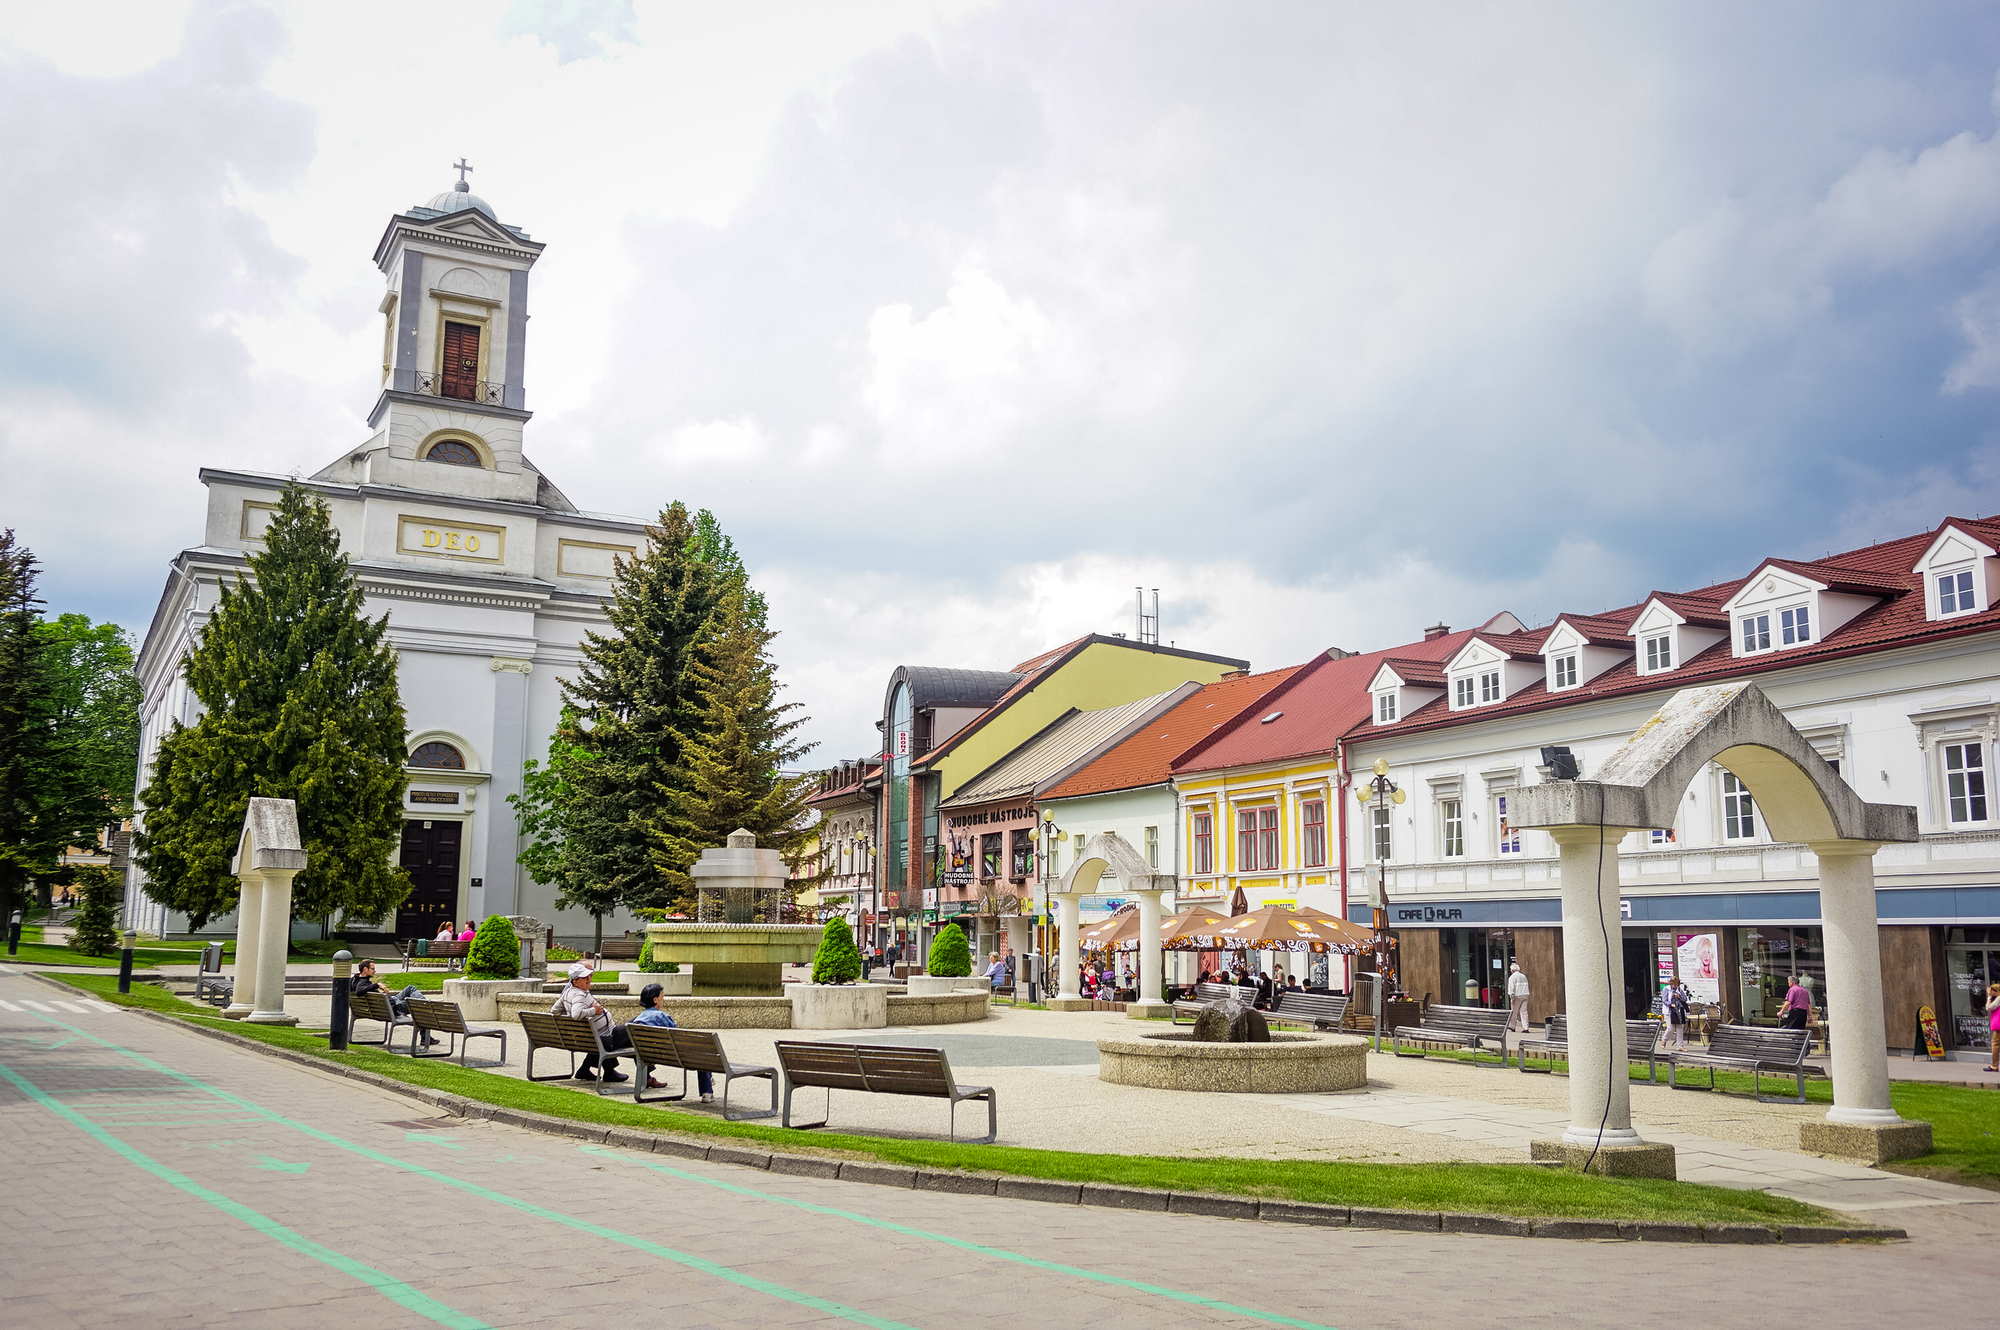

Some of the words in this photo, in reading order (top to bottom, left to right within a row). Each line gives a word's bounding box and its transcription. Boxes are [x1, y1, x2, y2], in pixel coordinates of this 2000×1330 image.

[422, 529, 480, 552] DEO
[951, 809, 989, 829] HUDOBNÉ
[990, 805, 1034, 823] NÁSTROJE
[1398, 909, 1422, 920] CAFE
[1436, 908, 1462, 920] ALFA
